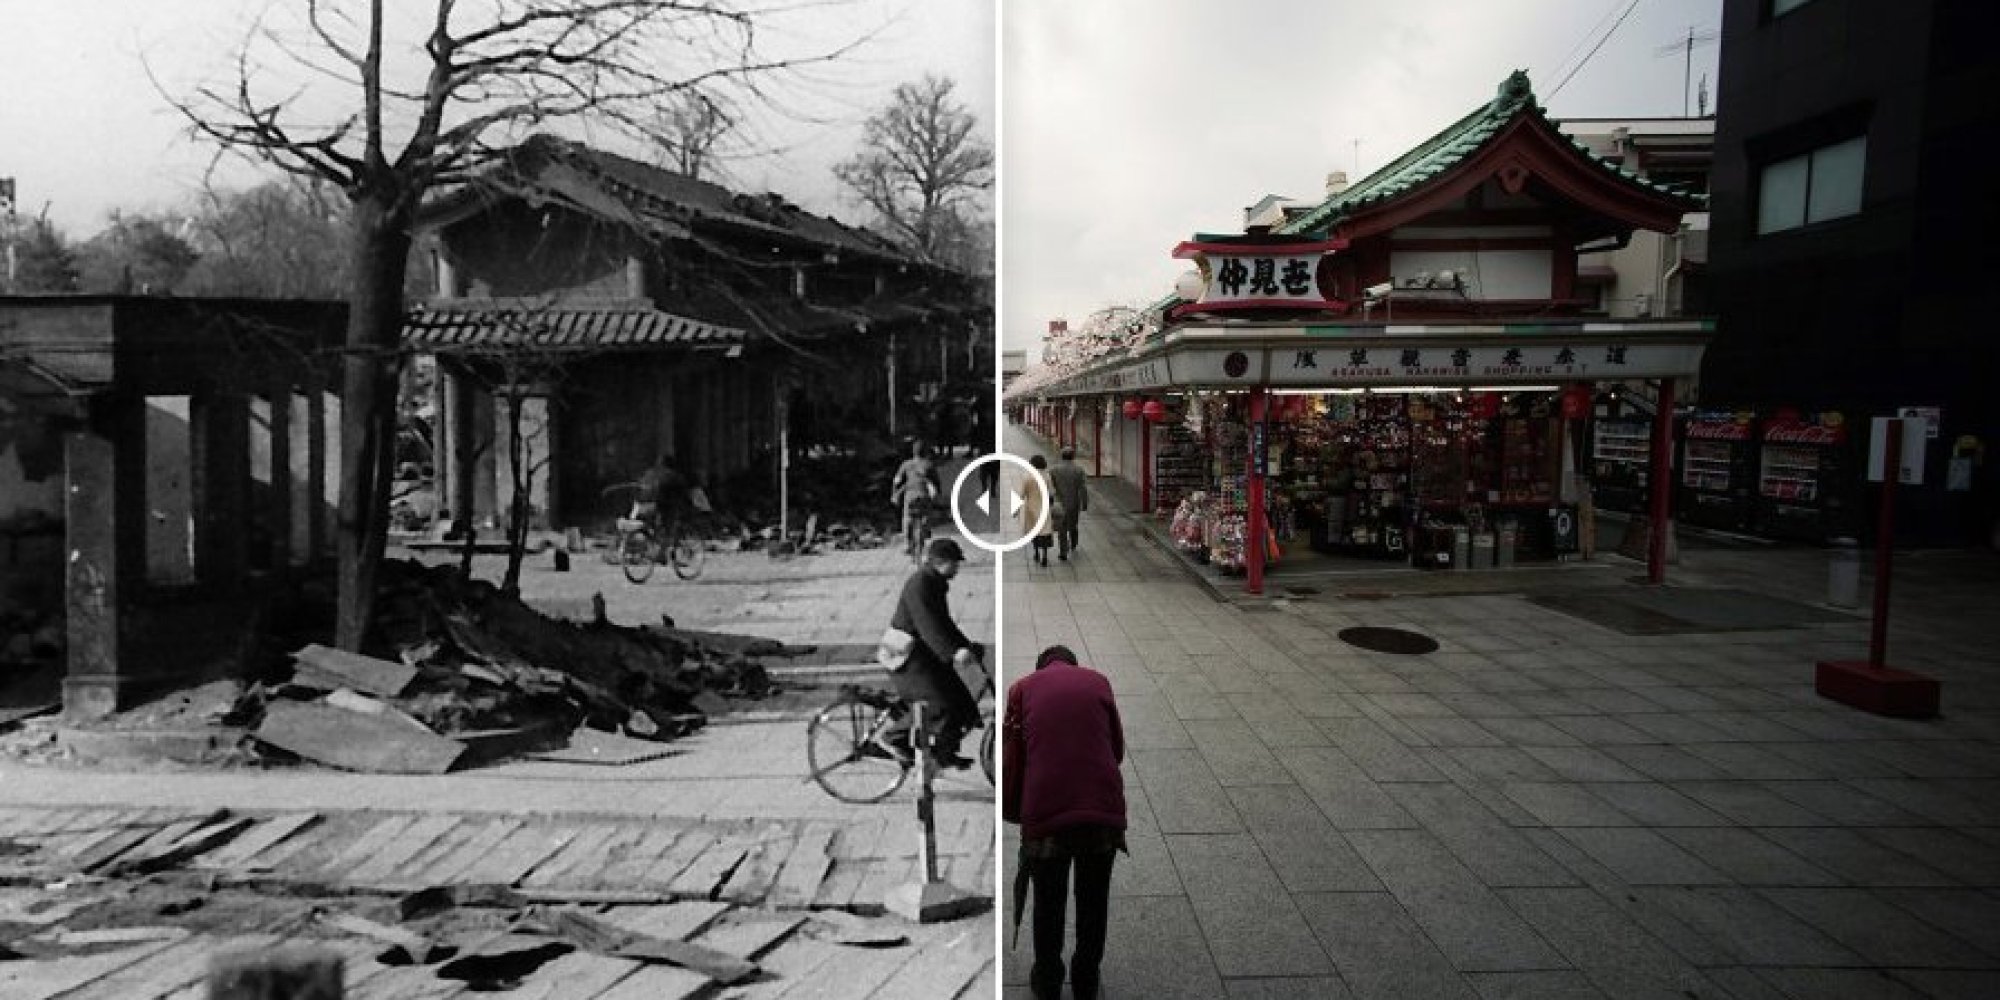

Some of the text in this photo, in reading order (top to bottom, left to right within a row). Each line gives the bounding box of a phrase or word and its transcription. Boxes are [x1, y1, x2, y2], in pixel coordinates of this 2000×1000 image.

[1218, 258, 1311, 297] 仲見世
[1484, 365, 1552, 375] SHOPPING
